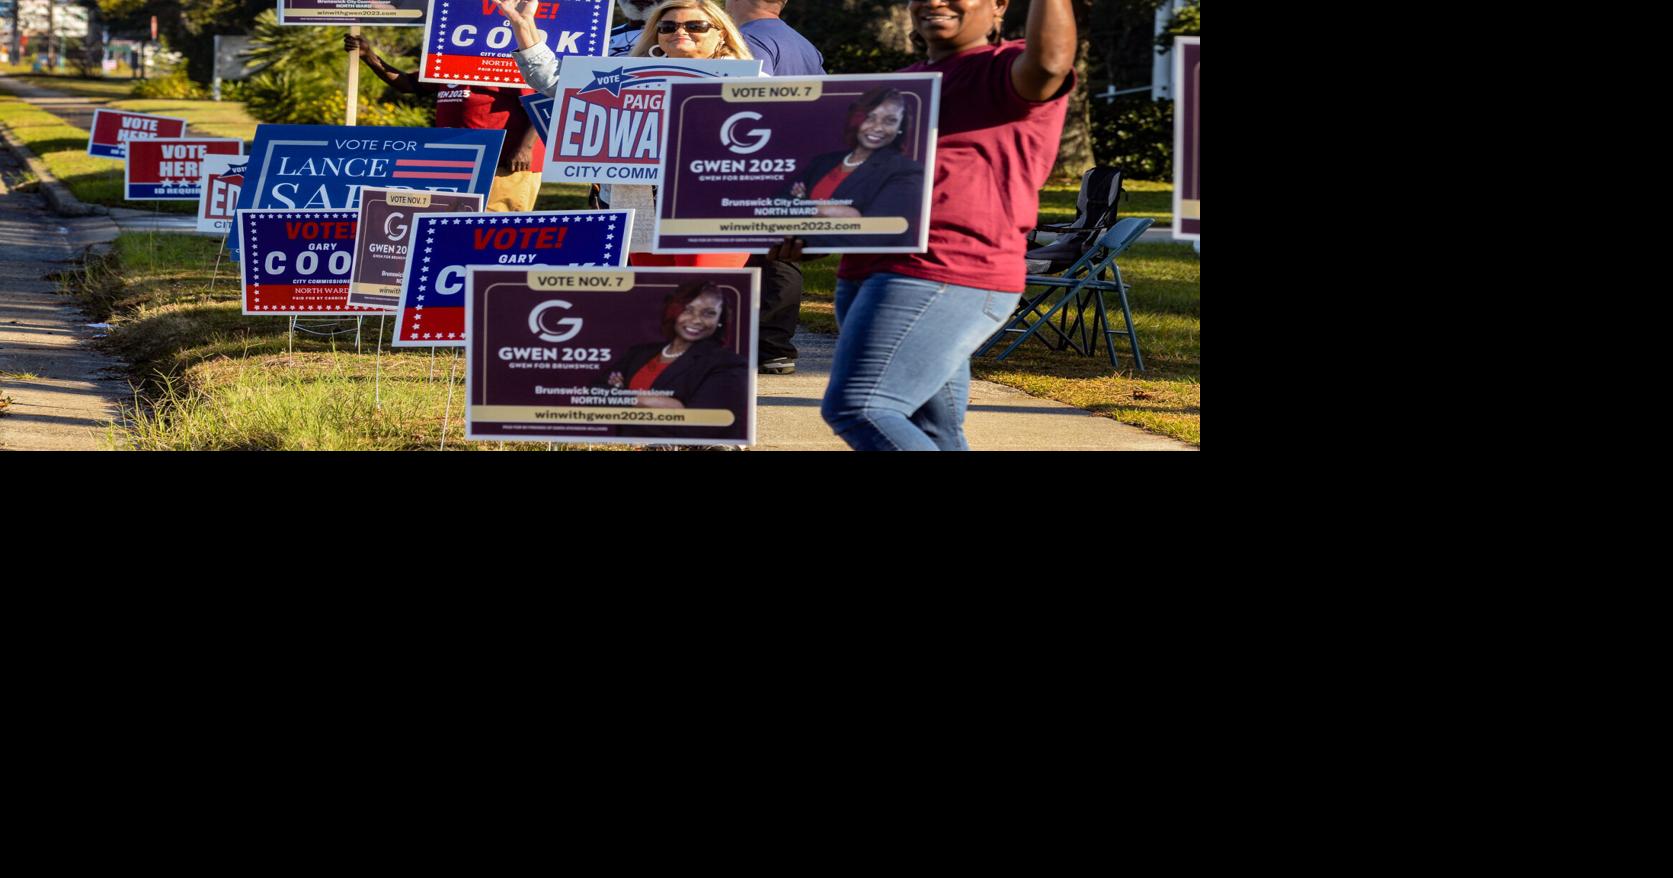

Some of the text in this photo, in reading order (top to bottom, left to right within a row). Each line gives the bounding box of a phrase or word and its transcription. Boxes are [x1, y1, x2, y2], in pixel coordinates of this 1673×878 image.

[597, 75, 620, 85] VOTE
[732, 86, 812, 98] VOTE NOV. 7
[122, 116, 158, 131] VOTE
[560, 96, 659, 159] EDWA
[335, 139, 417, 151] VOTE FOR
[161, 144, 208, 159] VOTE
[276, 156, 389, 178] LANCE
[690, 158, 797, 173] GWEN 2023
[564, 166, 659, 180] CITY COMM
[390, 195, 407, 204] VOTE
[721, 198, 772, 207] Brunswick
[774, 199, 791, 208] City
[754, 207, 818, 215] NORTH WARD
[720, 221, 861, 232] winwithgwen2023.com
[473, 227, 567, 250] VOTE!
[308, 242, 337, 251] GARY
[369, 243, 395, 253] GWEN
[498, 253, 536, 264] GARY
[537, 276, 624, 287] VOTE NOV. 7
[498, 347, 612, 362] GWEN 2023
[552, 362, 600, 370] BRUNSWICK
[535, 386, 675, 397] Brunswick City Commissioner
[571, 396, 638, 405] NORTH WARD
[535, 410, 685, 422] winwithgwen2023.com
